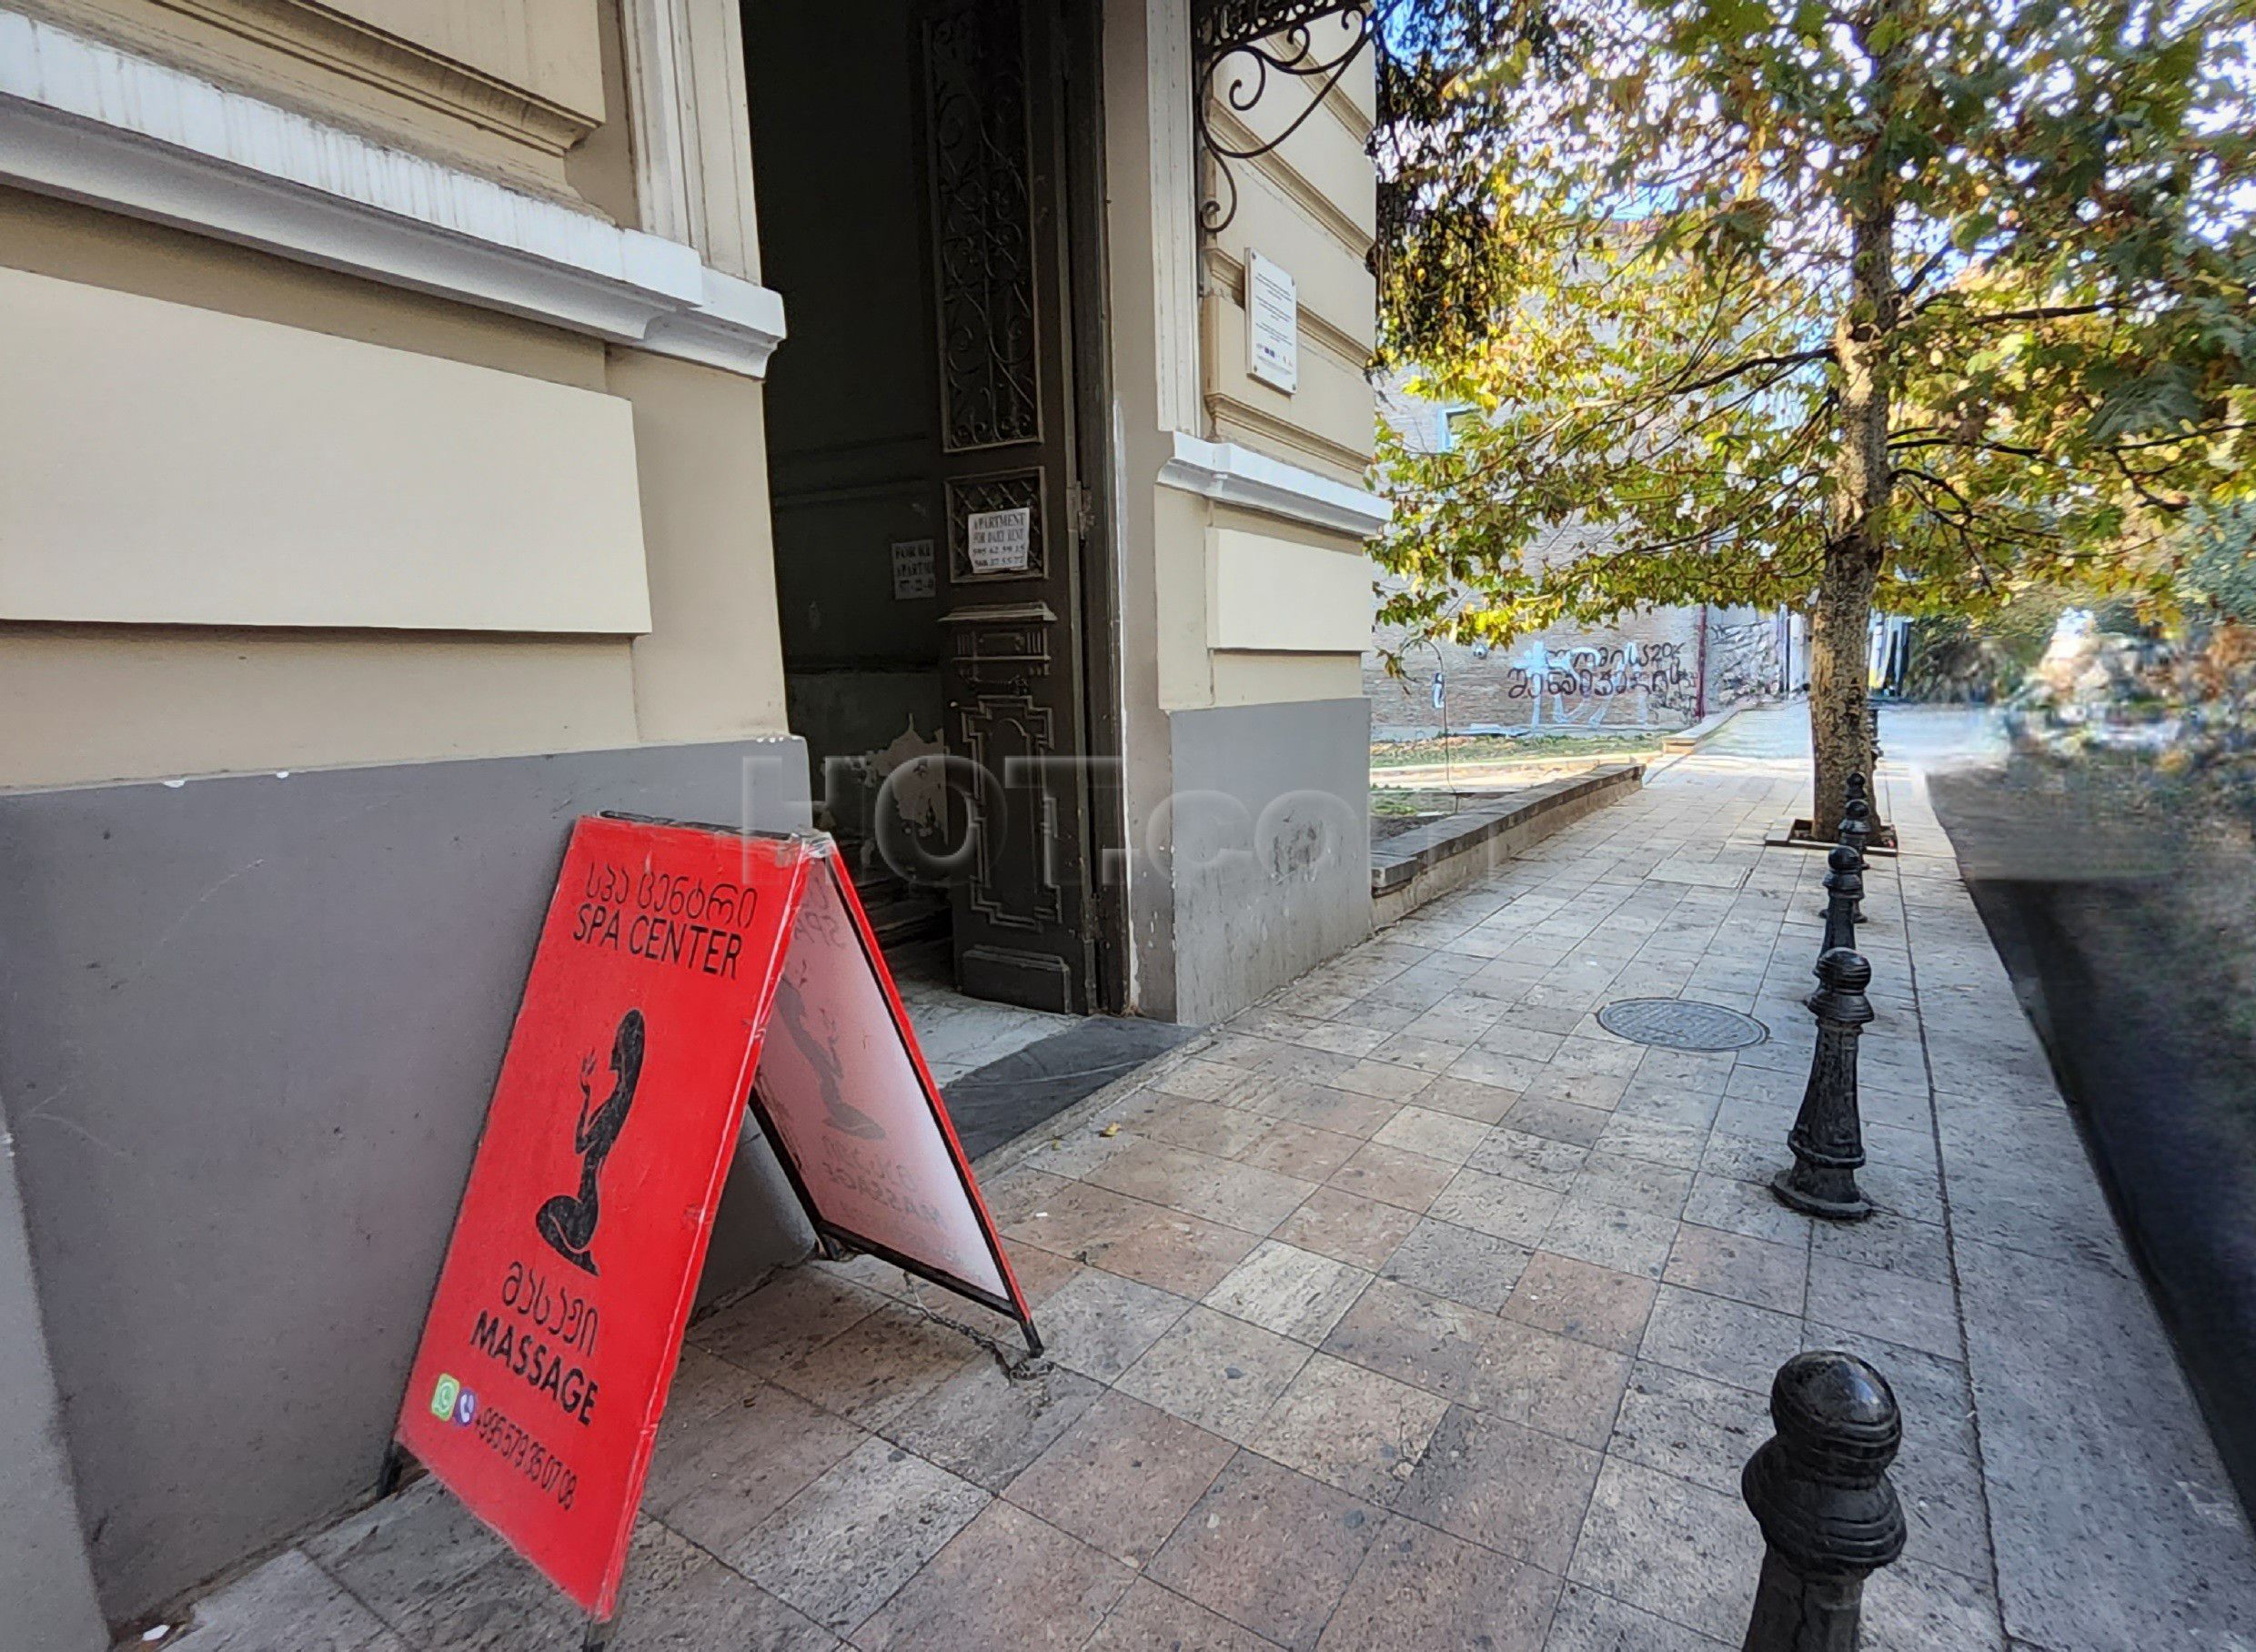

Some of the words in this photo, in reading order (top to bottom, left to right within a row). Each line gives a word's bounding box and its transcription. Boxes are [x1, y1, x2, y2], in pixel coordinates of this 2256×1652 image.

[973, 511, 1026, 530] APARTMENT
[638, 870, 759, 929] ცენტრი
[573, 902, 620, 951] SPA
[629, 914, 743, 980] CENTER
[502, 1260, 599, 1357] მასაჟი
[470, 1309, 599, 1426] MASSAGE
